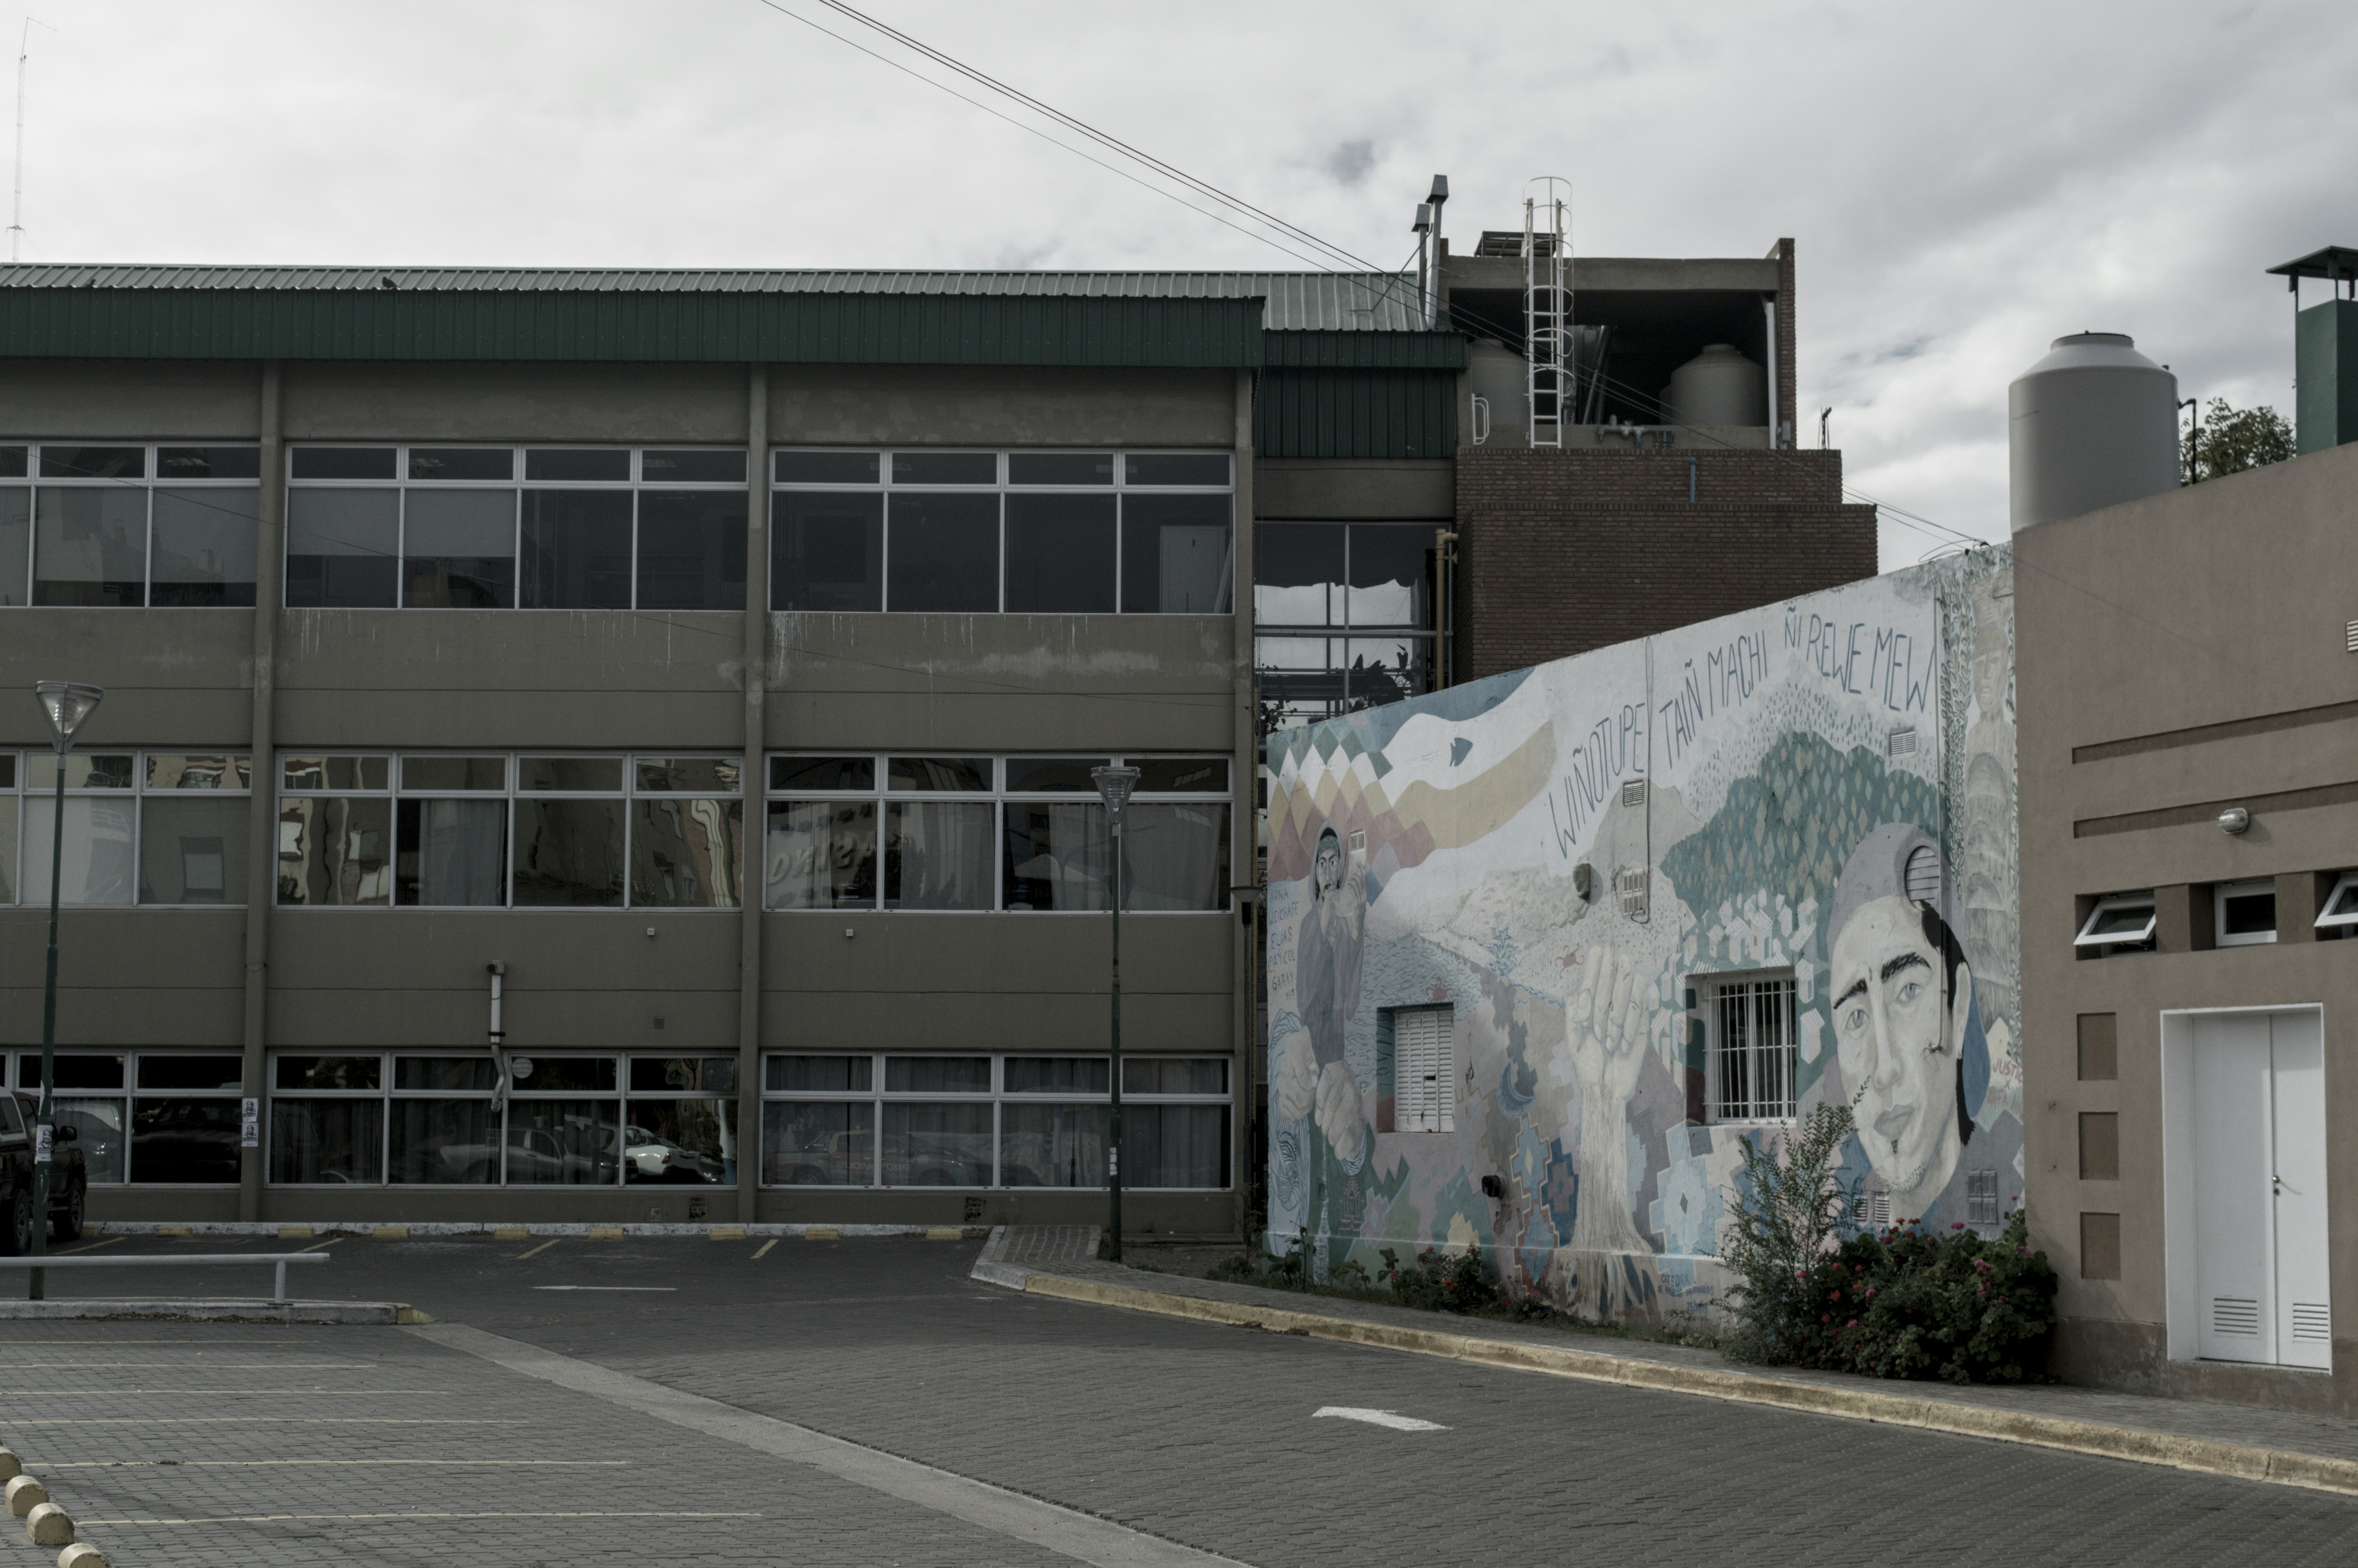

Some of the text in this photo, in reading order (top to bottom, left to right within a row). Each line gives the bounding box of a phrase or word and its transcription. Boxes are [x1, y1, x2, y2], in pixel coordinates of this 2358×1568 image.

[1549, 606, 1934, 859] WIÑOTUPE TAIÑ MACHI ÑI REWE MEW
[1271, 887, 1288, 902] KONA
[1272, 971, 1294, 990] GARAY
[1661, 1274, 1690, 1287] CATEDRA
